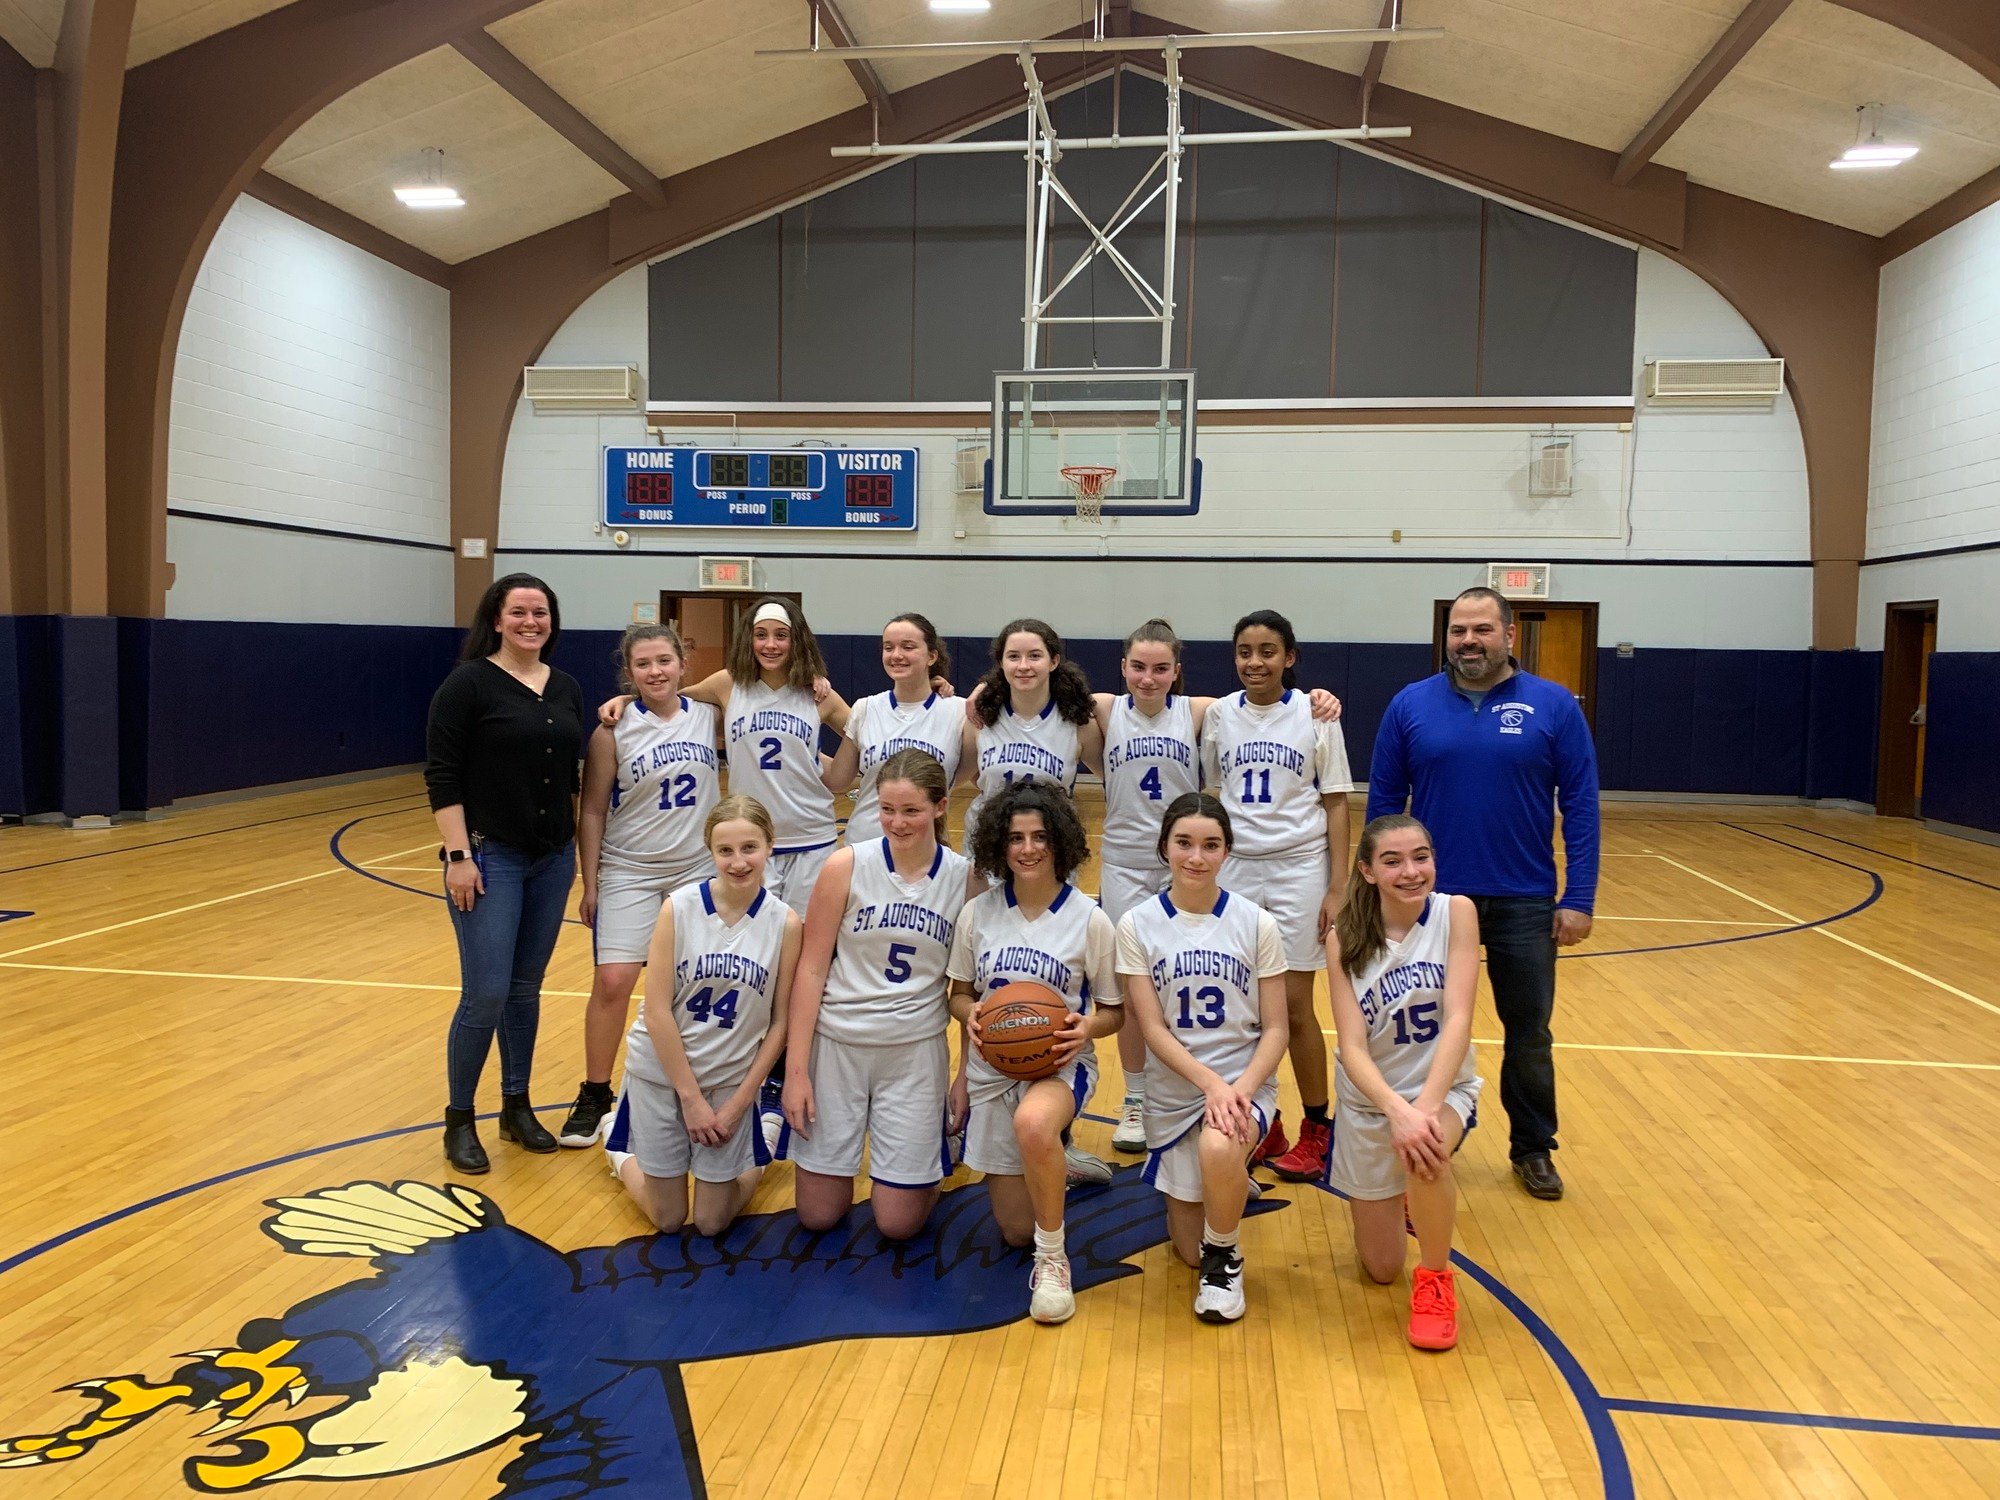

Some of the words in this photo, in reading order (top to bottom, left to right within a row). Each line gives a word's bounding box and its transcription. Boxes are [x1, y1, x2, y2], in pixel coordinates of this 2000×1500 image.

[626, 451, 674, 468] HOME
[837, 453, 902, 470] VISITOR
[706, 491, 727, 500] POSS
[729, 503, 767, 514] PERIOD
[790, 491, 811, 500] POSS
[639, 509, 673, 521] BONUS
[845, 512, 880, 523] BONUS
[1507, 571, 1529, 587] EXIT
[731, 716, 745, 742] ST.
[749, 711, 812, 747] AUGUSTINE
[631, 754, 649, 784] ST.
[652, 741, 716, 771] AUGUSTINE
[759, 737, 782, 770] 2
[863, 744, 877, 769] ST.
[981, 746, 996, 771] ST.
[997, 743, 1064, 781] AUGUSTINE
[1109, 745, 1122, 772] ST.
[1125, 736, 1191, 768] AUGUSTINE
[1234, 741, 1305, 777] AUGUSTINE
[659, 773, 697, 810] 12
[1139, 766, 1162, 800] 4
[1241, 768, 1272, 803] 11
[853, 905, 876, 932] ST.
[878, 902, 954, 949] AUGUSTINE
[693, 953, 769, 998] AUGUSTINE
[884, 942, 917, 984] 5
[993, 946, 1072, 995] AUGUSTINE
[1152, 958, 1170, 992] ST.
[1173, 949, 1251, 996] AUGUSTINE
[1379, 961, 1445, 1006] AUGUSTIN
[685, 986, 739, 1029] 44
[987, 1016, 1050, 1034] PHENOM
[1176, 986, 1225, 1028] 13
[1391, 1001, 1440, 1045] 15
